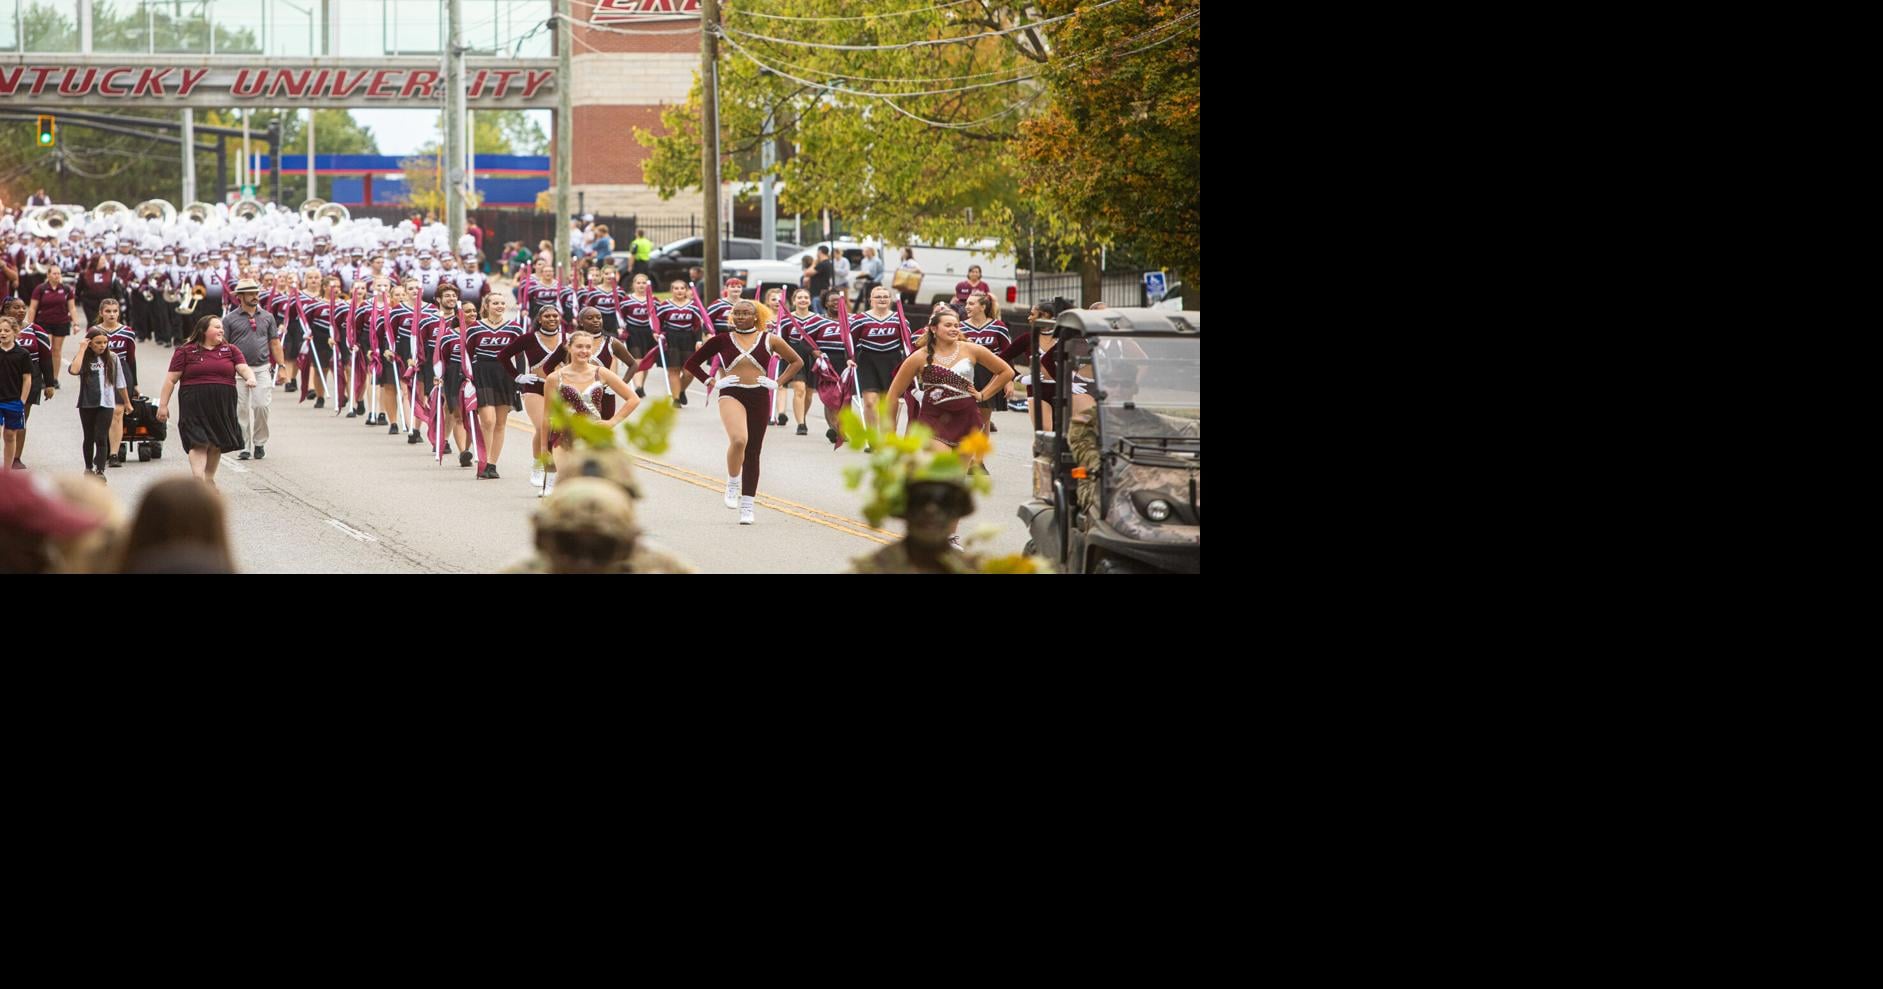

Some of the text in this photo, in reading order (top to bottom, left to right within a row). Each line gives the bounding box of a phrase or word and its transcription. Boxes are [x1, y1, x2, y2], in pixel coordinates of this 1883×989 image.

[229, 67, 555, 98] UNIVERITY
[210, 275, 219, 285] E
[422, 274, 430, 284] E
[466, 278, 475, 289] E
[867, 327, 895, 337] EKU
[479, 336, 510, 347] EKU
